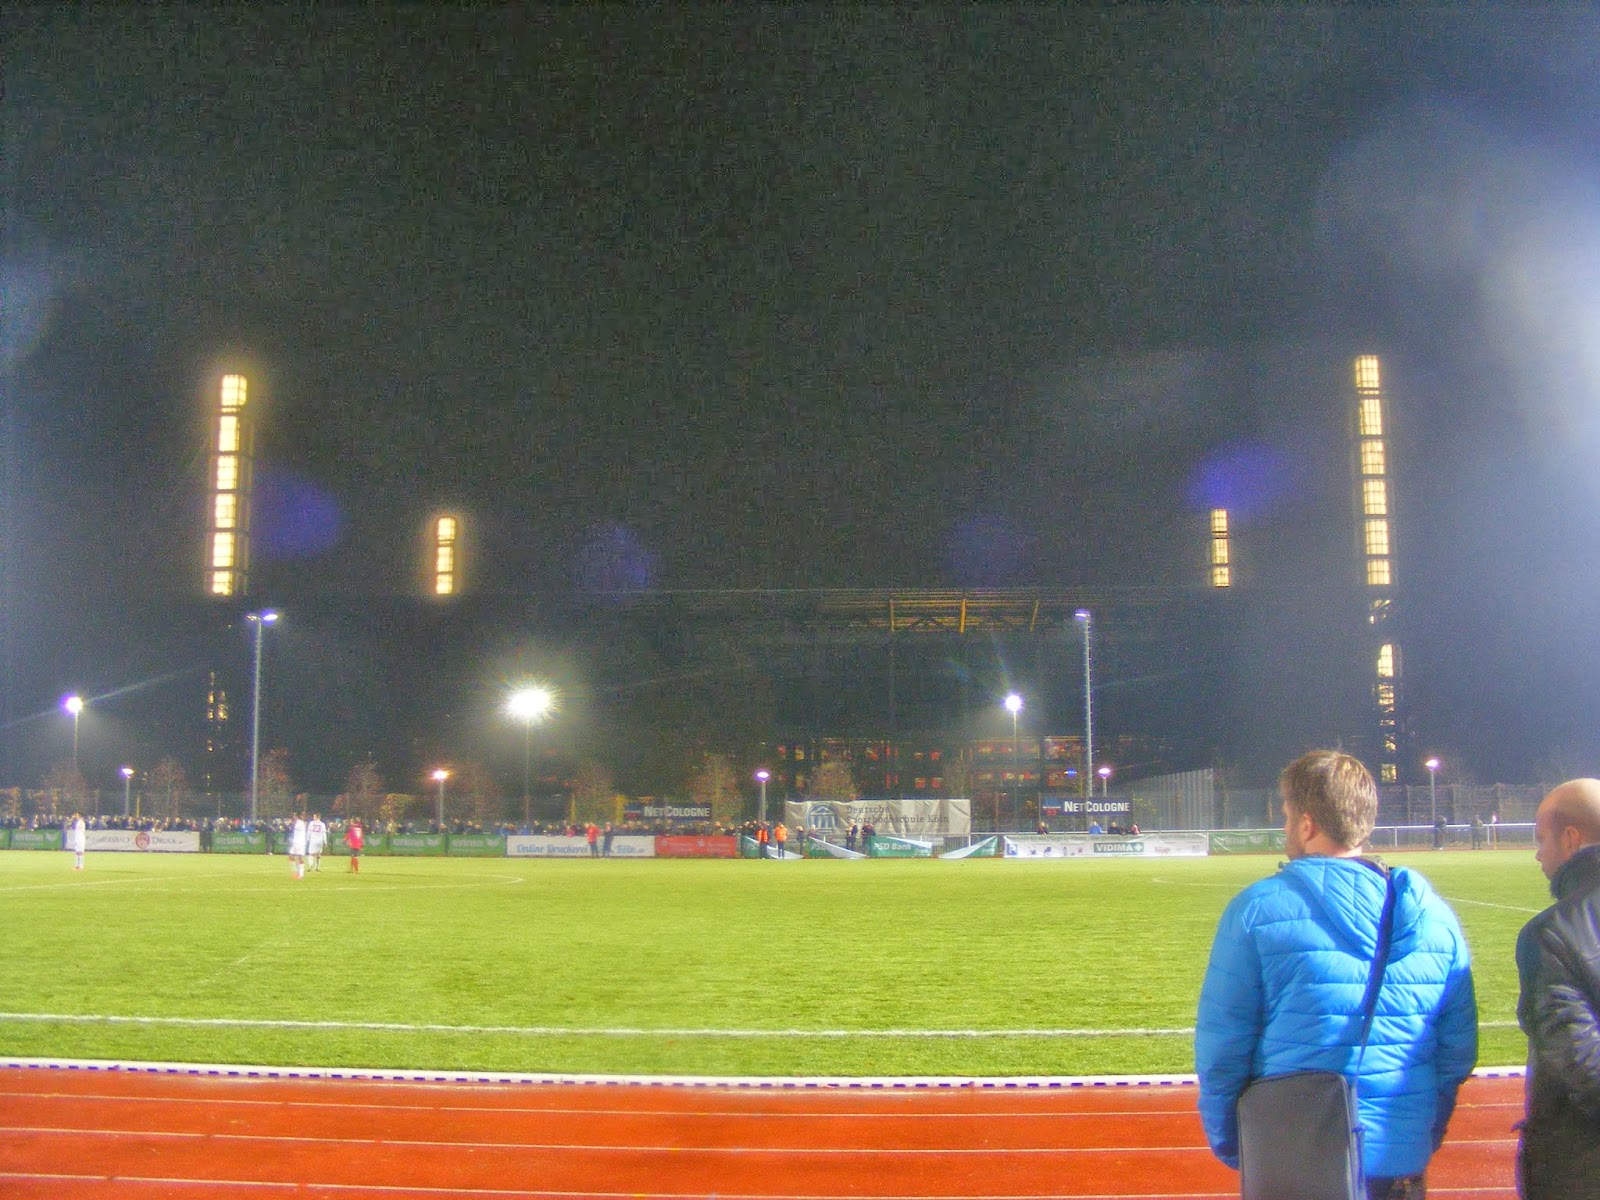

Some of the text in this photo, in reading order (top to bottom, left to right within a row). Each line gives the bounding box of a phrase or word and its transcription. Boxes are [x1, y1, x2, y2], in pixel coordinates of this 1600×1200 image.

[846, 805, 890, 814] Deutsche
[928, 814, 949, 823] Köln
[312, 824, 321, 832] 23
[516, 844, 544, 853] Online
[547, 844, 587, 853] Druckerei
[1096, 844, 1133, 852] VIDIMA
